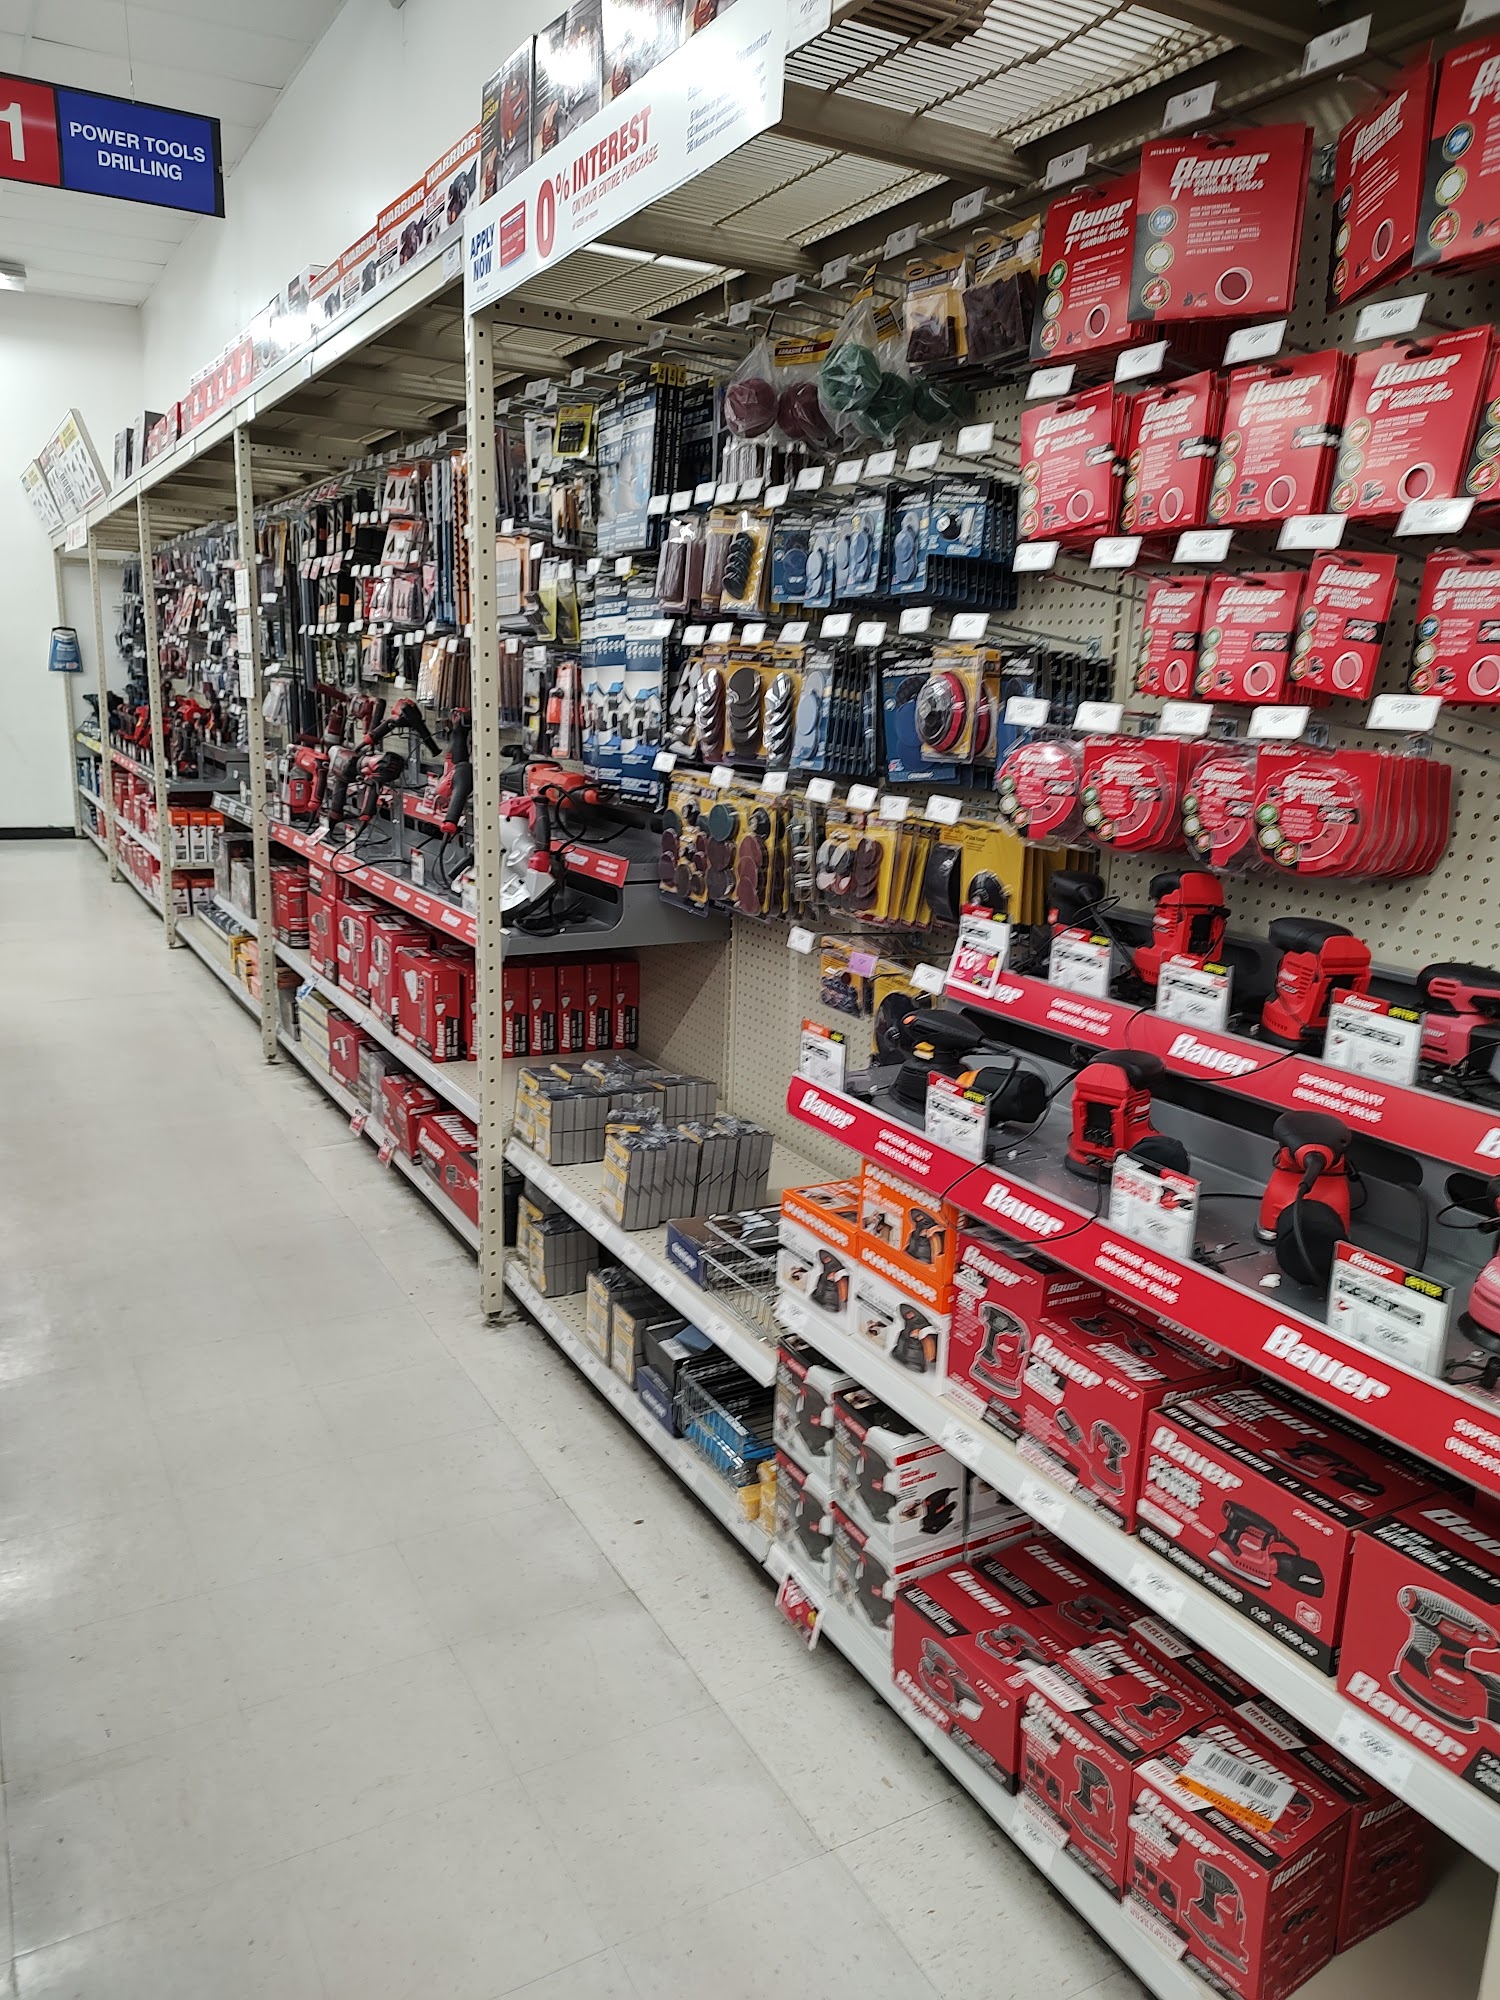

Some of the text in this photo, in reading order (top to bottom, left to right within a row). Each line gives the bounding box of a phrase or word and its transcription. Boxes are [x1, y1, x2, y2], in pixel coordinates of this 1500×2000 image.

[69, 121, 206, 163] POWER TOOLS
[427, 132, 477, 190] WARRIOR
[572, 104, 652, 196] INTEREST
[97, 150, 183, 182] DRILLING
[599, 169, 621, 199] ENTIRE
[621, 143, 659, 183] PURCHASE
[1171, 152, 1271, 181] Bauer
[379, 186, 425, 234] WARRIOR
[1066, 198, 1134, 236] Bauer
[470, 222, 496, 261] APPLY
[473, 249, 492, 283] NOW
[1243, 375, 1322, 406] Bauer
[1371, 353, 1461, 390] Bauer
[1035, 405, 1097, 439] Bauer
[1142, 394, 1198, 425] Bauer
[1318, 564, 1381, 589] Bauer
[1437, 567, 1500, 590] Baue
[1167, 1033, 1259, 1077] Bauer
[799, 1088, 857, 1130] Bauer
[1297, 1072, 1386, 1107] SUPERIOR QUALITY
[906, 1141, 934, 1161] QUALITY
[982, 1182, 1066, 1237] Bauer
[961, 1245, 1022, 1287] Bauer
[1100, 1240, 1182, 1288] SUPERIOR QUALITY
[1047, 1281, 1084, 1295] Bauer
[1081, 1291, 1102, 1302] SYSTEM
[1031, 1334, 1103, 1390] Bauer
[1261, 1324, 1391, 1404] Bauer
[1151, 1425, 1244, 1491] Bauer
[1419, 1508, 1500, 1557] Bau
[1024, 1545, 1088, 1588] Bauer
[947, 1570, 1012, 1618] Bauer
[1098, 1640, 1171, 1692] Bauer
[1345, 1671, 1468, 1762] Bauer
[1137, 1788, 1222, 1856] Bauer
[1360, 1800, 1404, 1829] Baue
[1271, 1848, 1319, 1892] Bauer
